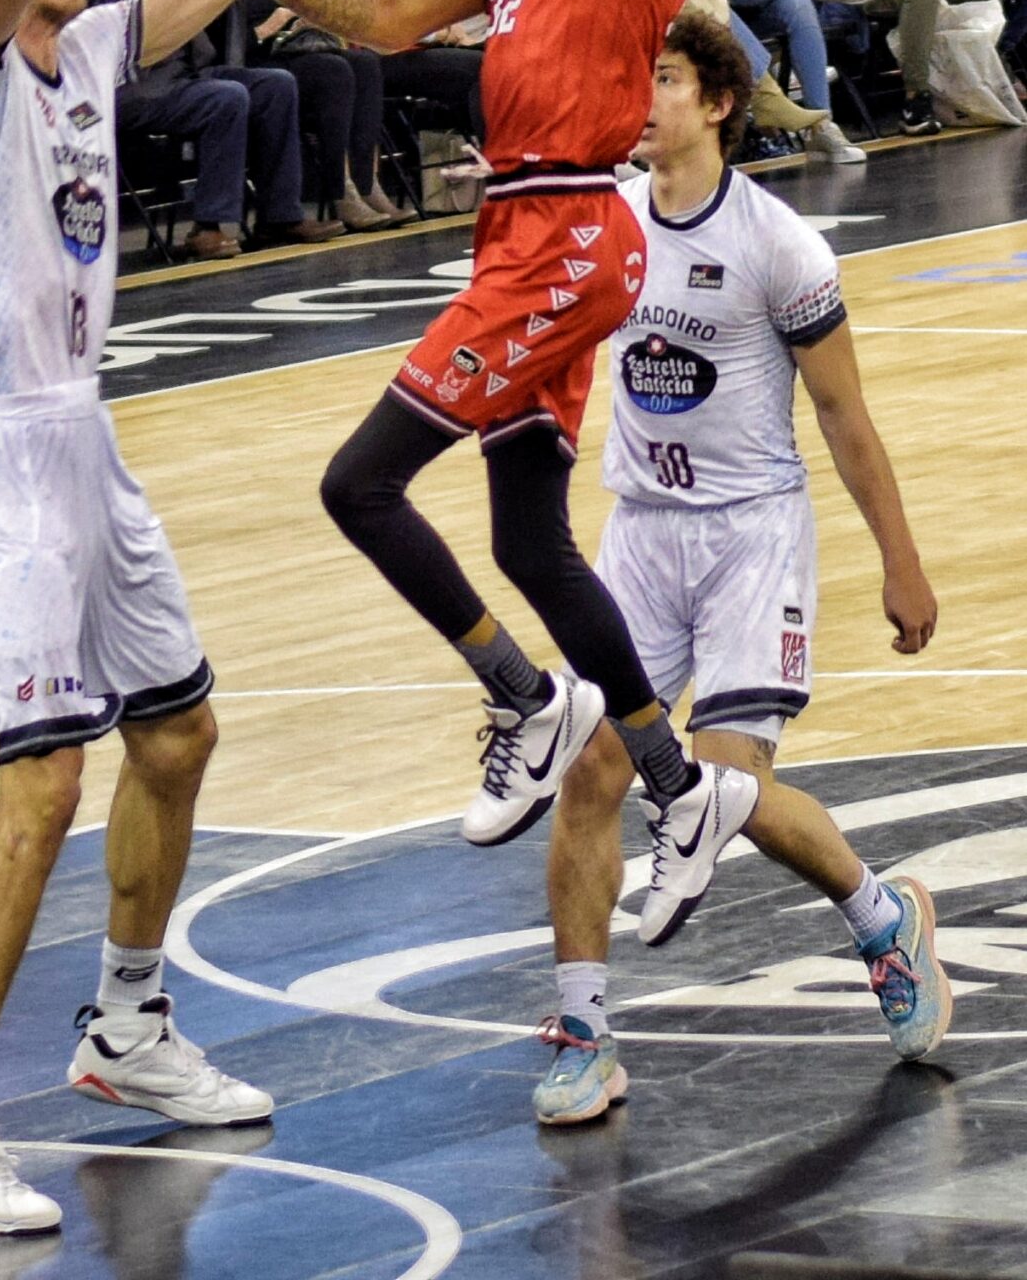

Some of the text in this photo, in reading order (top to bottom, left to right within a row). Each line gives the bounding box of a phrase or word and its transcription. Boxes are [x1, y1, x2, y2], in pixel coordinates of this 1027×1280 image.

[617, 305, 717, 342] RADOIRO
[626, 353, 698, 377] Estrella
[631, 371, 695, 395] Galicia
[648, 442, 695, 490] 50
